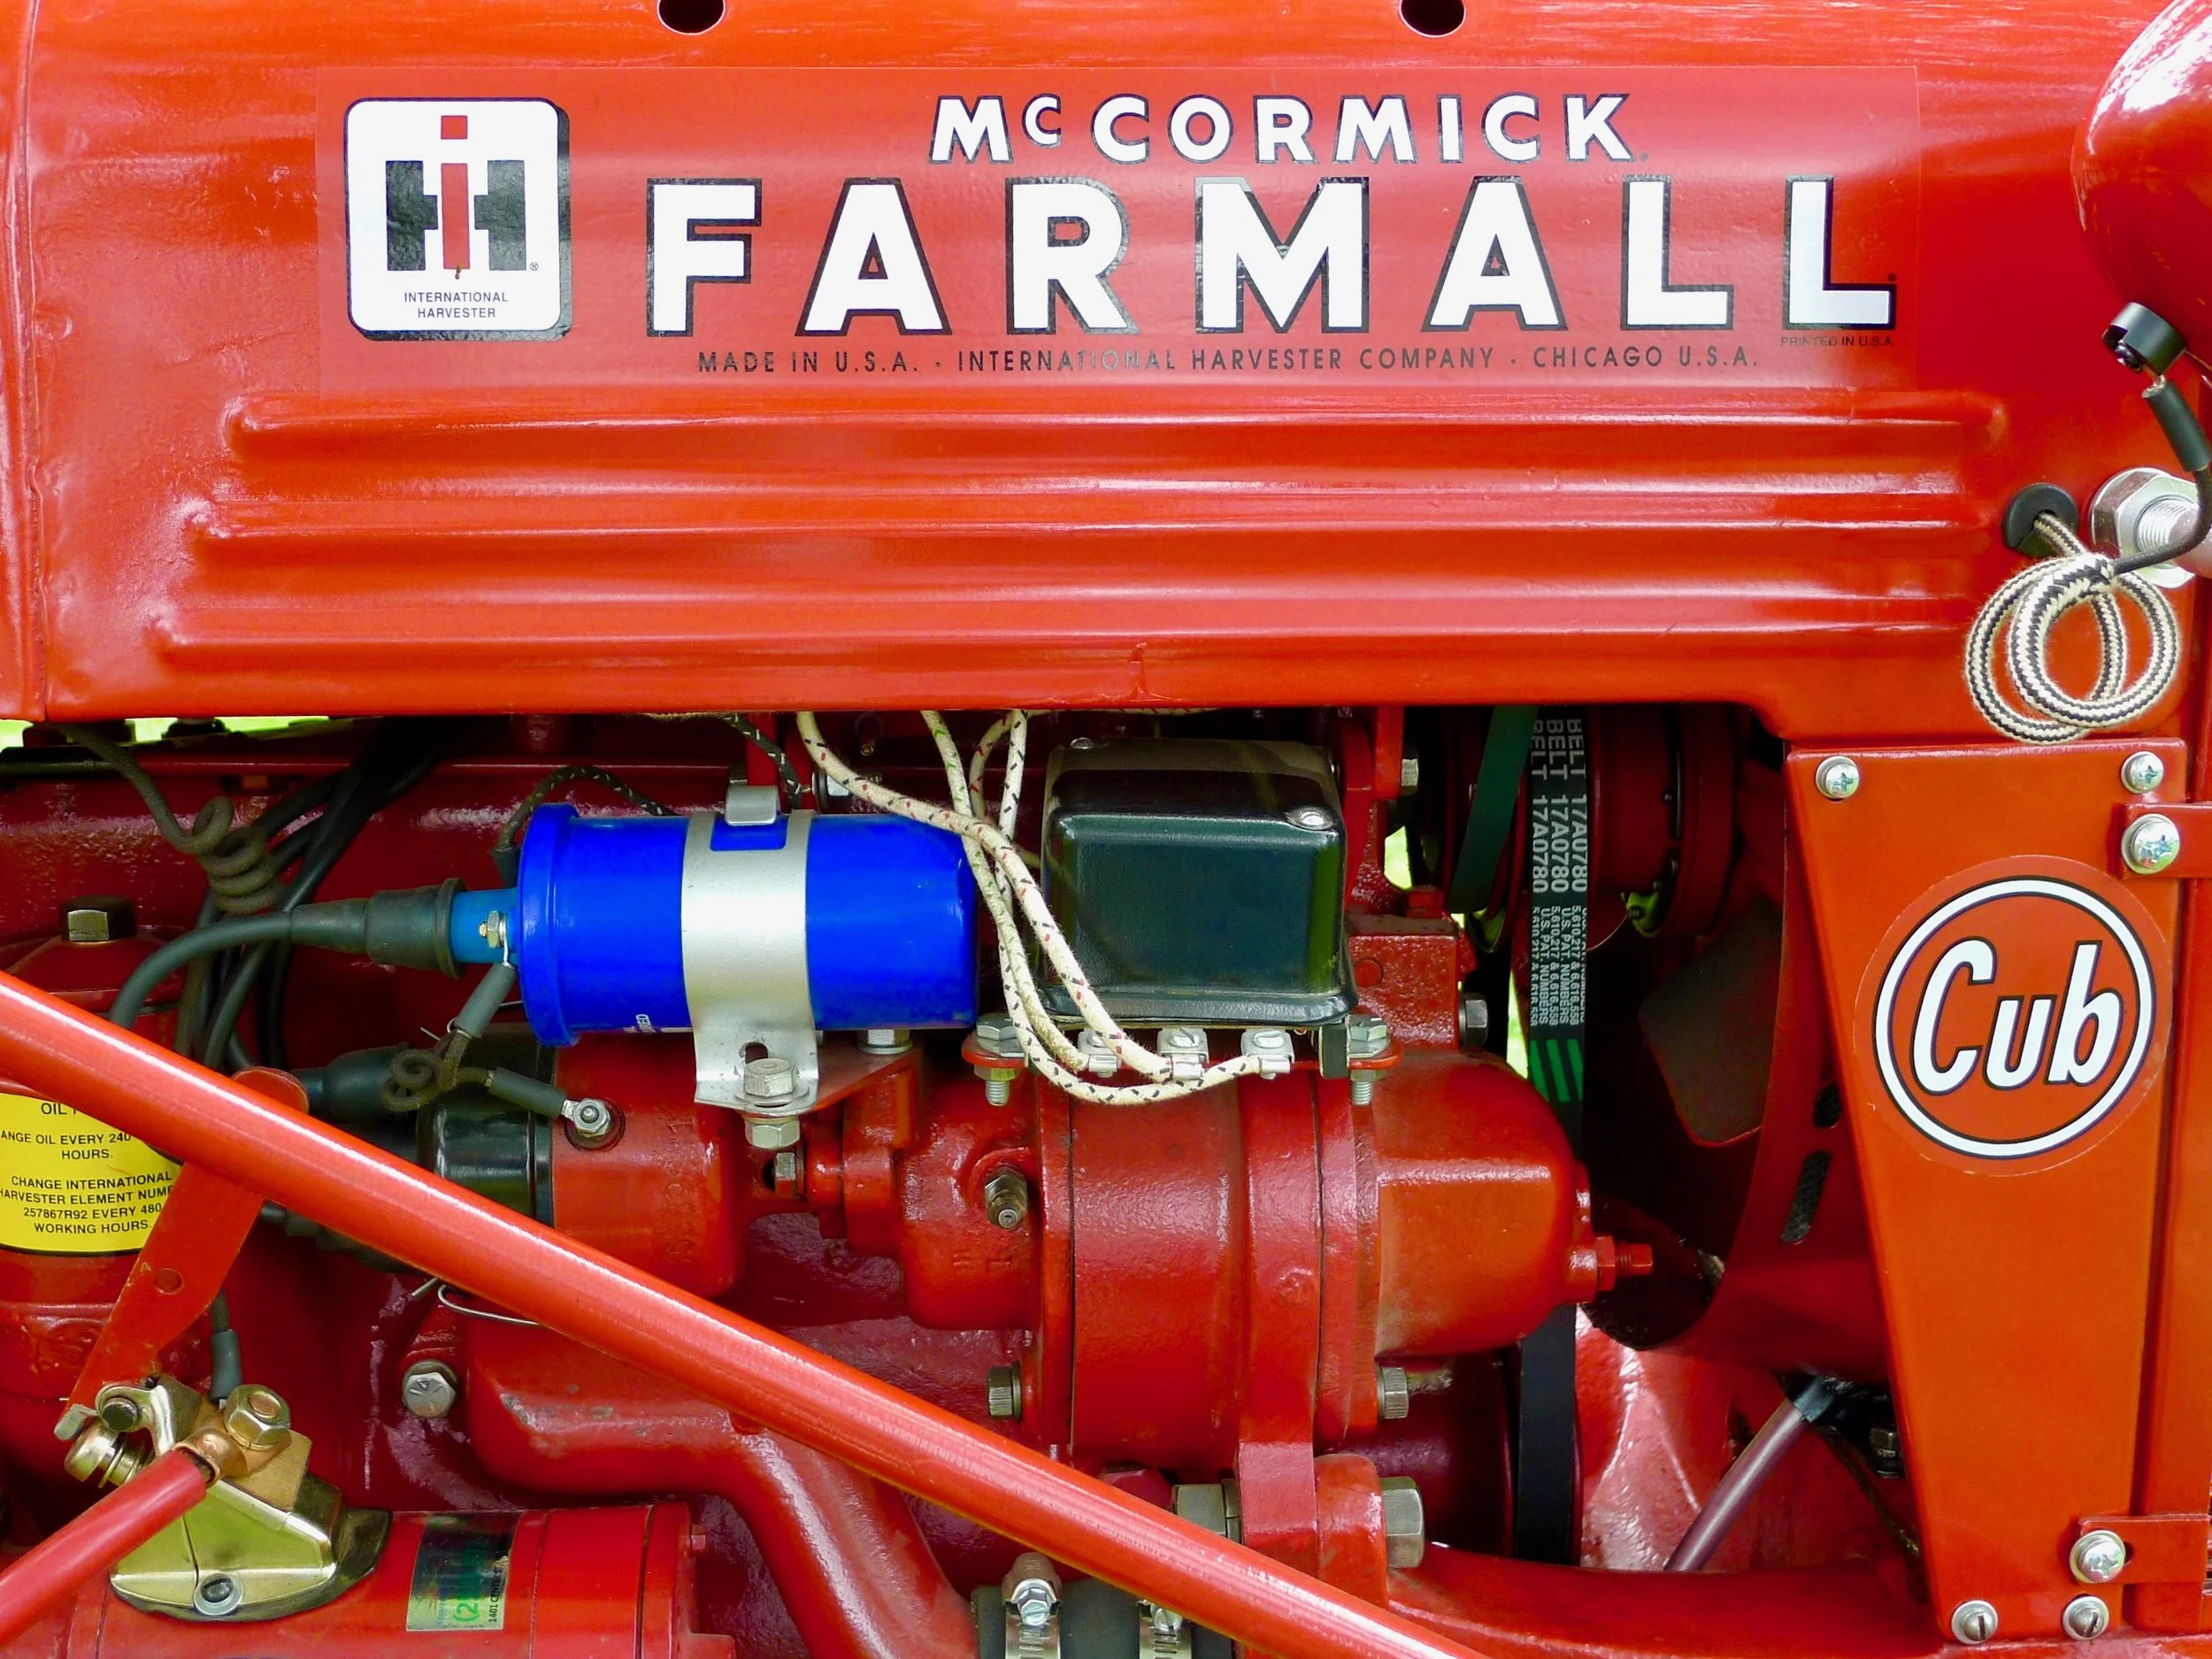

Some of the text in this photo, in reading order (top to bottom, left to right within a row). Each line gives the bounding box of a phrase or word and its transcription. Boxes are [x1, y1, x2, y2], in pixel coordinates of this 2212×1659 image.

[647, 176, 1896, 337] FARMALL
[404, 292, 509, 303] INTERNATIONAL
[418, 308, 496, 319] HARVESTER
[1780, 335, 1838, 347] PRINTED
[1841, 335, 1855, 347] IN
[698, 345, 1758, 373] MADE IN U.S.A. INTERNATIONAL HARVESTER COMPANY CHICAGO U.S.A.
[1547, 718, 1570, 894] BELT 17A0780
[1566, 718, 1588, 894] BELT 17A0780
[1532, 794, 1548, 894] 17A0780
[1550, 905, 1561, 959] 5,610,217
[1571, 905, 1582, 959] 5,610,217
[1539, 907, 1551, 1025] U.S. PAT. NUMBERS
[1559, 907, 1571, 1025] U.S. PAT. NUMBERS
[1910, 935, 2124, 1096] Cub
[41, 1102, 67, 1115] OIL
[35, 1133, 57, 1145] OIL
[60, 1133, 104, 1145] EVERY
[109, 1132, 132, 1143] 240
[12, 1171, 173, 1190] CHANGE INTERNATIONAL
[23, 1202, 162, 1219] 257867R92 EVERY 480
[70, 1191, 134, 1205] ELEMENT
[34, 1222, 96, 1234] WORKING
